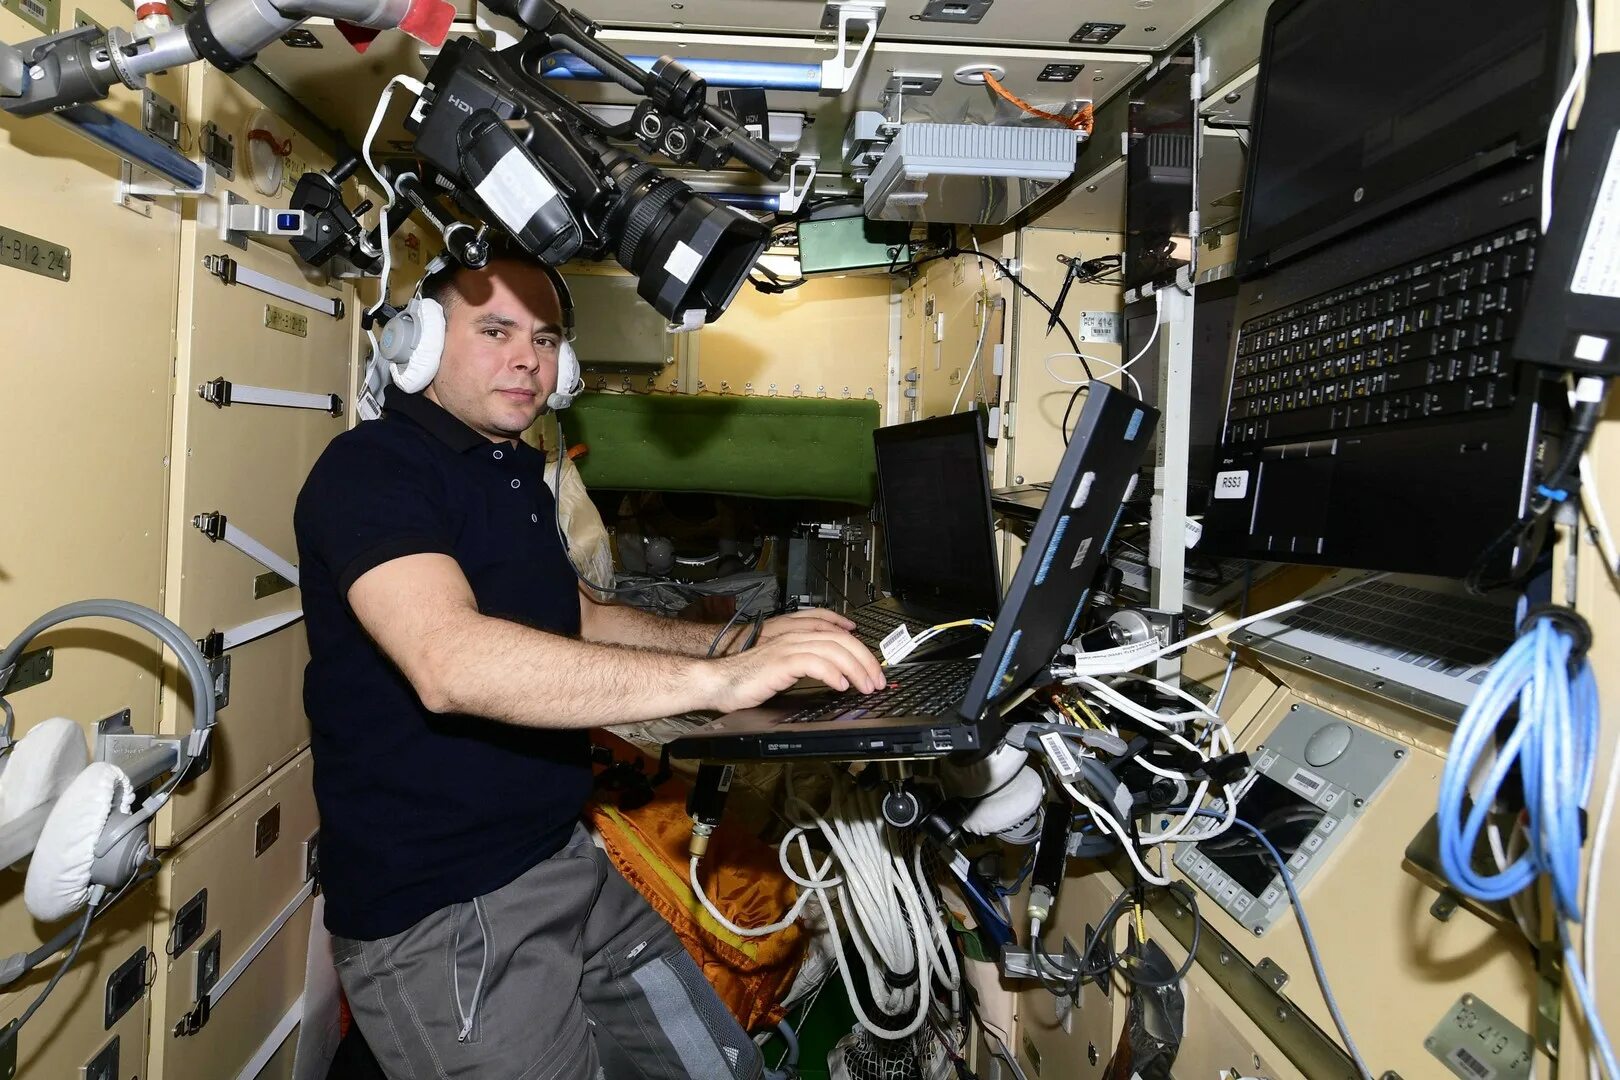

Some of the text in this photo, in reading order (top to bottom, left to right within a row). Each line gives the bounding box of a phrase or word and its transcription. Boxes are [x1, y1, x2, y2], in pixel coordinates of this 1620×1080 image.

[1223, 476, 1241, 488] RSS3
[1325, 820, 1333, 829] 5
[1311, 838, 1318, 847] 6
[1296, 855, 1304, 863] 7
[1268, 891, 1275, 900] 9
